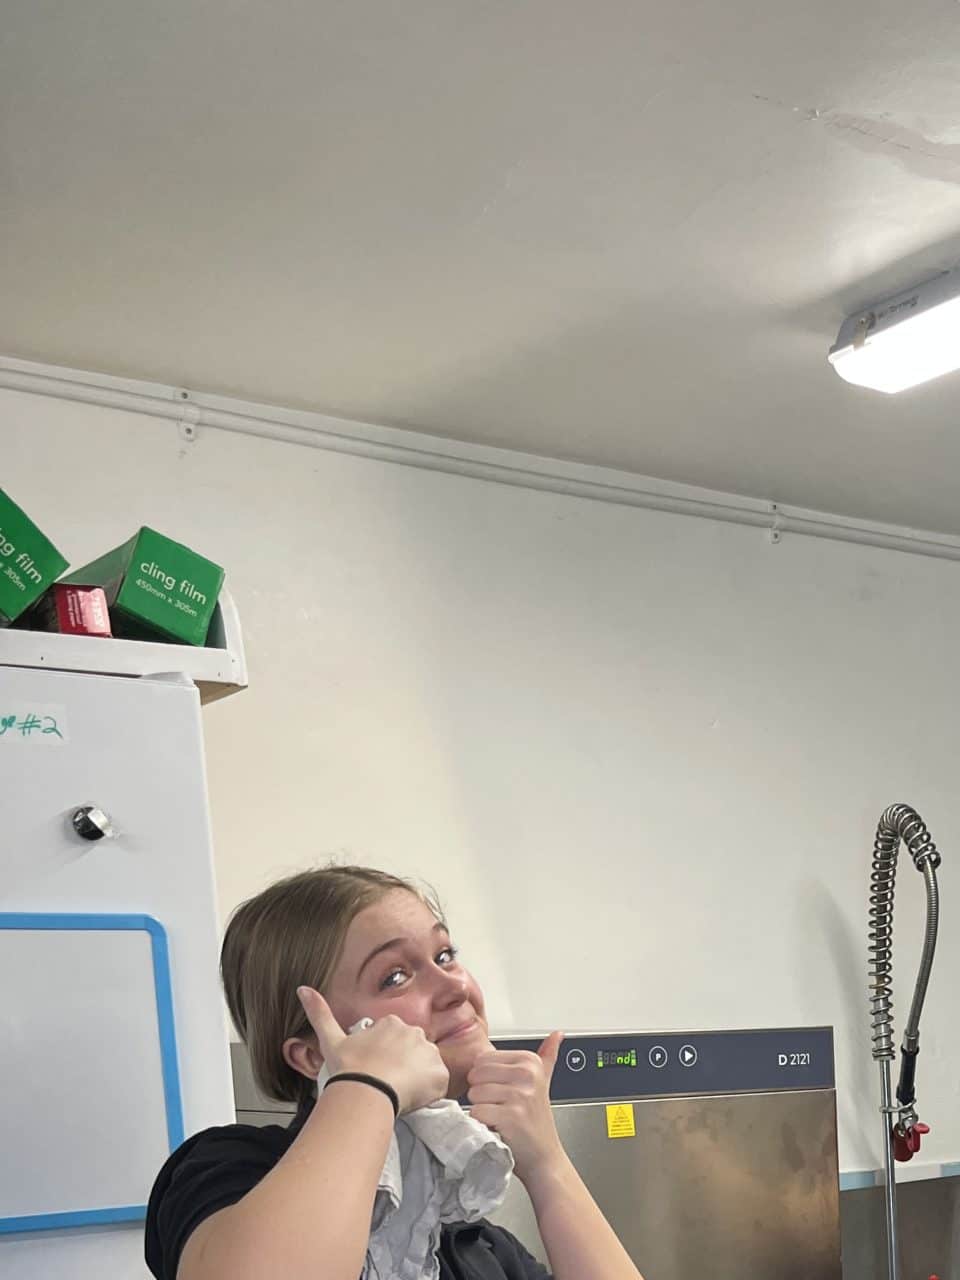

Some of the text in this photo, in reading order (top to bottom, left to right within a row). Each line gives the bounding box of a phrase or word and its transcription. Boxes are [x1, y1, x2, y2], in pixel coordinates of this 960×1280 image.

[15, 553, 42, 584] film
[140, 561, 207, 605] cling film
[135, 578, 167, 601] 450mm
[174, 599, 198, 617] 305m
[655, 1052, 662, 1061] P
[778, 1053, 810, 1066] D 2121
